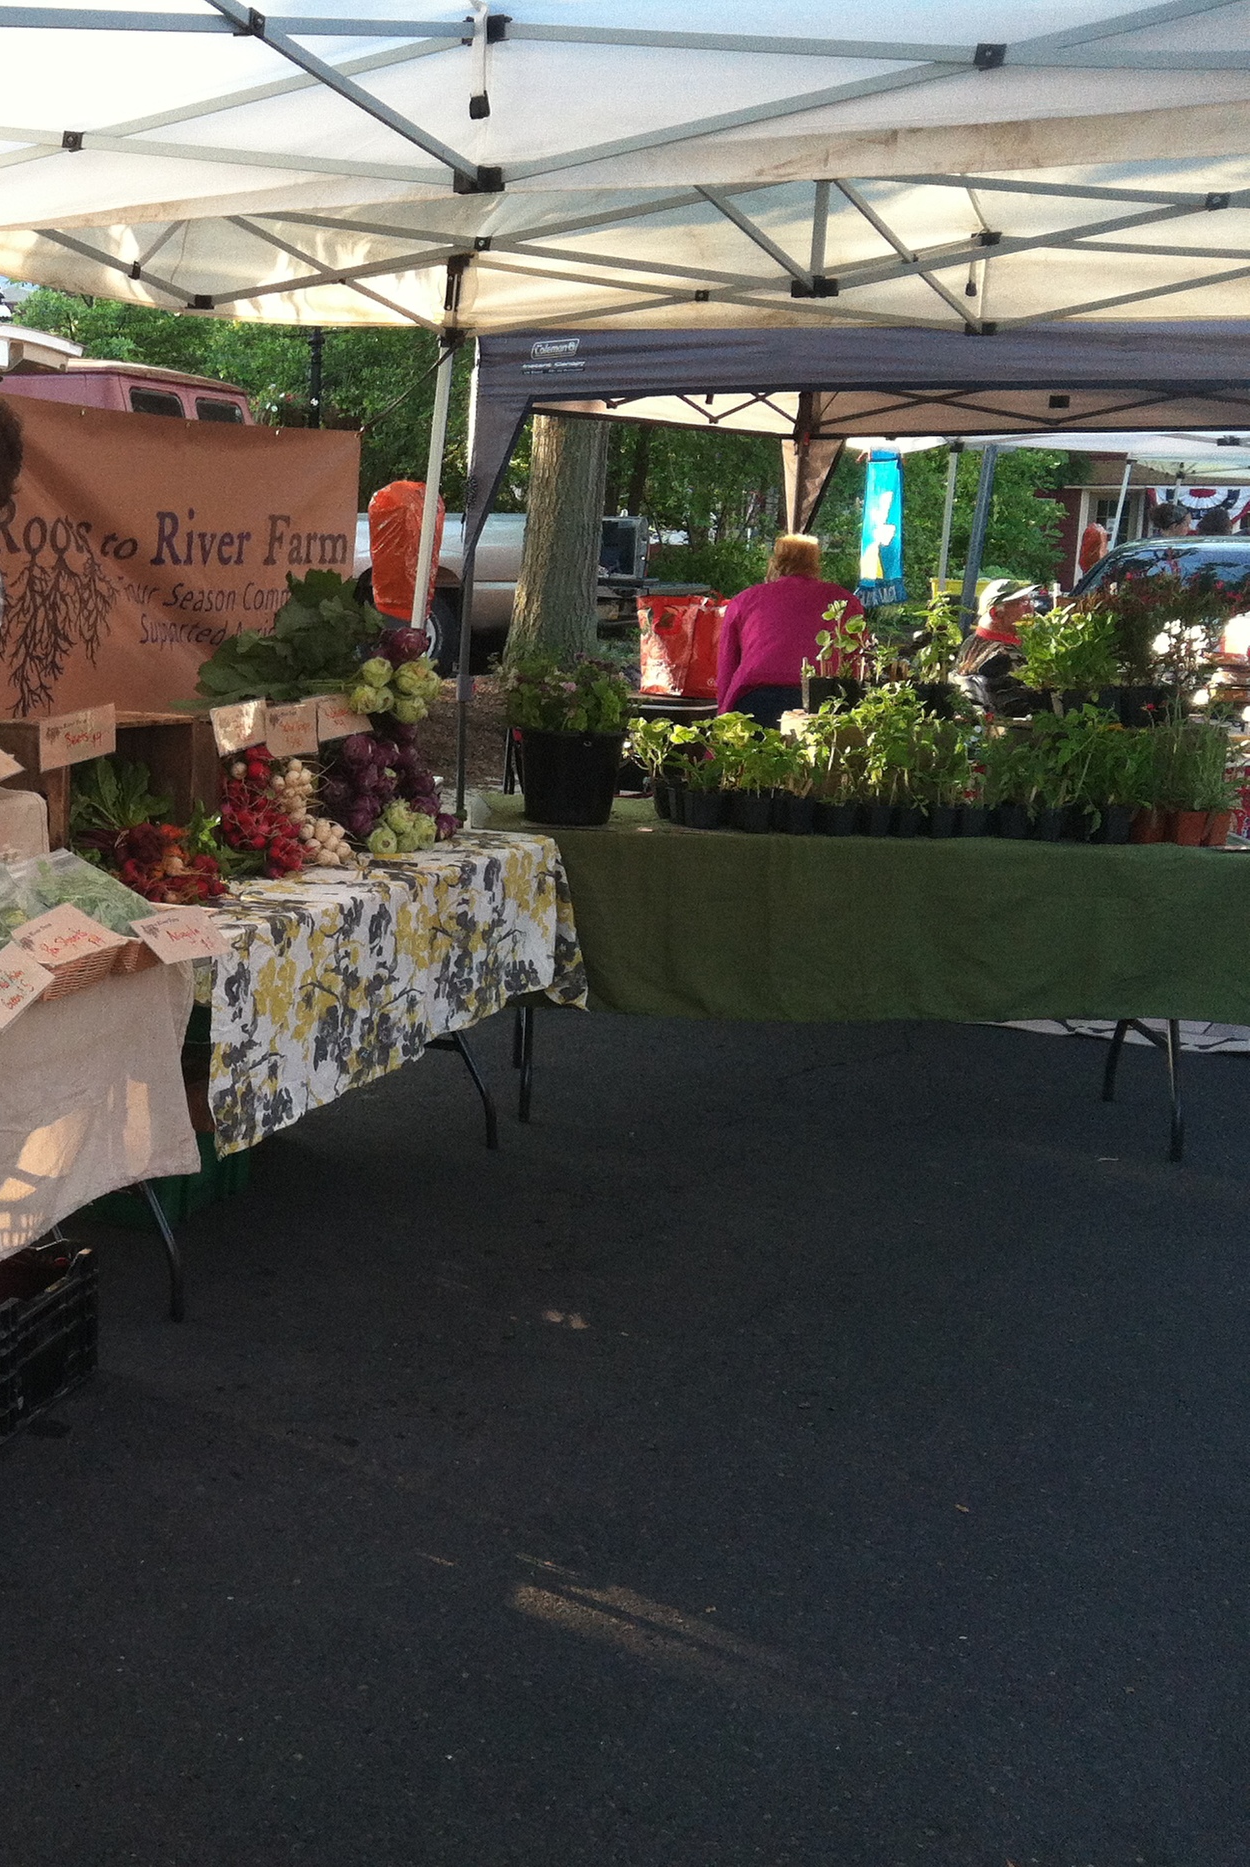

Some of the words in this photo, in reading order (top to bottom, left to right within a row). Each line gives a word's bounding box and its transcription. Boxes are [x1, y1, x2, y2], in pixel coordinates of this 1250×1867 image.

[101, 532, 138, 561] to
[150, 508, 251, 567] River
[263, 514, 349, 567] Farm
[163, 582, 236, 613] Season
[139, 613, 228, 648] Supported
